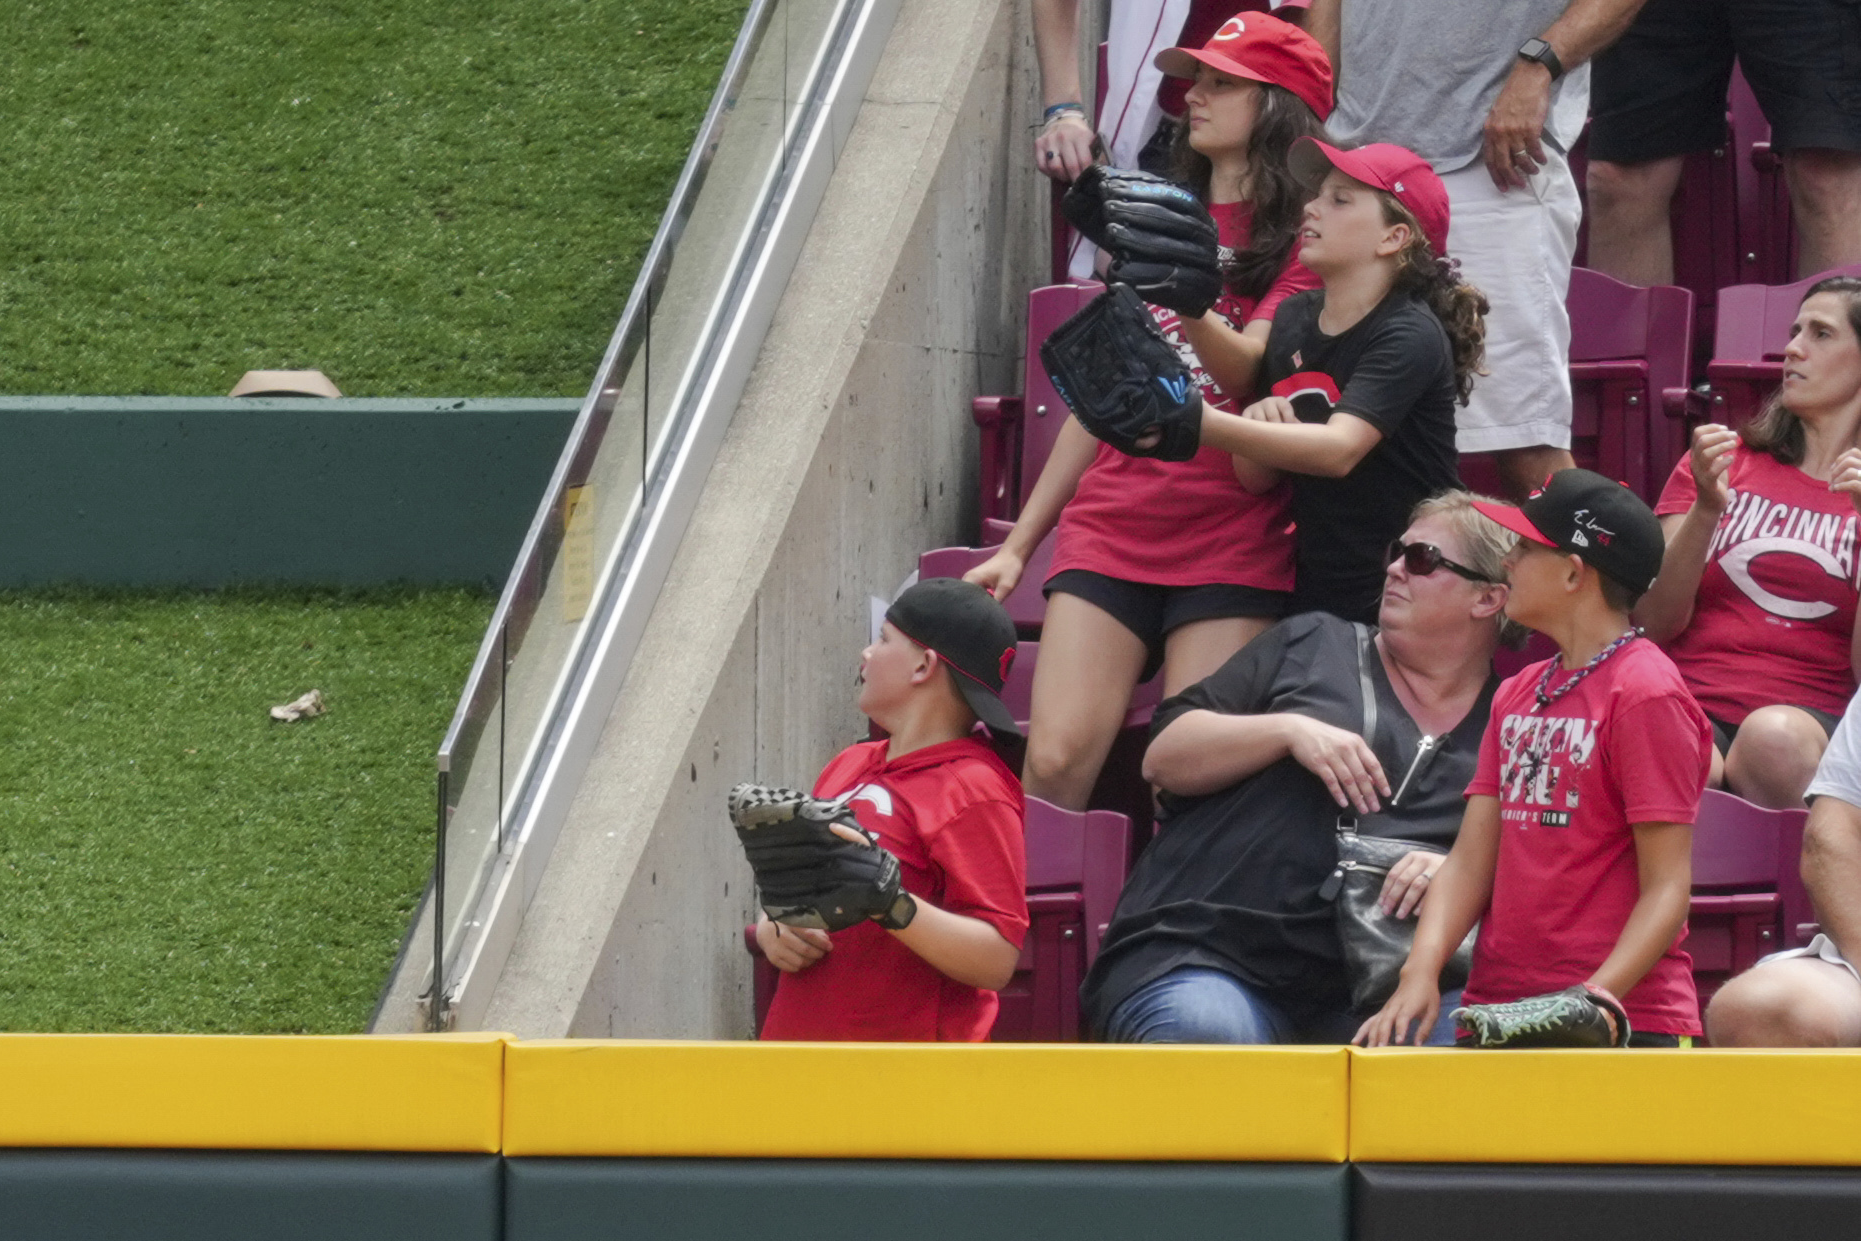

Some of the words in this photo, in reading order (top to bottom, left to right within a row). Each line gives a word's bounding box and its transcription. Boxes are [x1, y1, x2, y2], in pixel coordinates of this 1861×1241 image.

[1213, 17, 1246, 41] C
[1131, 184, 1194, 203] EASTON
[1704, 488, 1861, 592] CINCINNA
